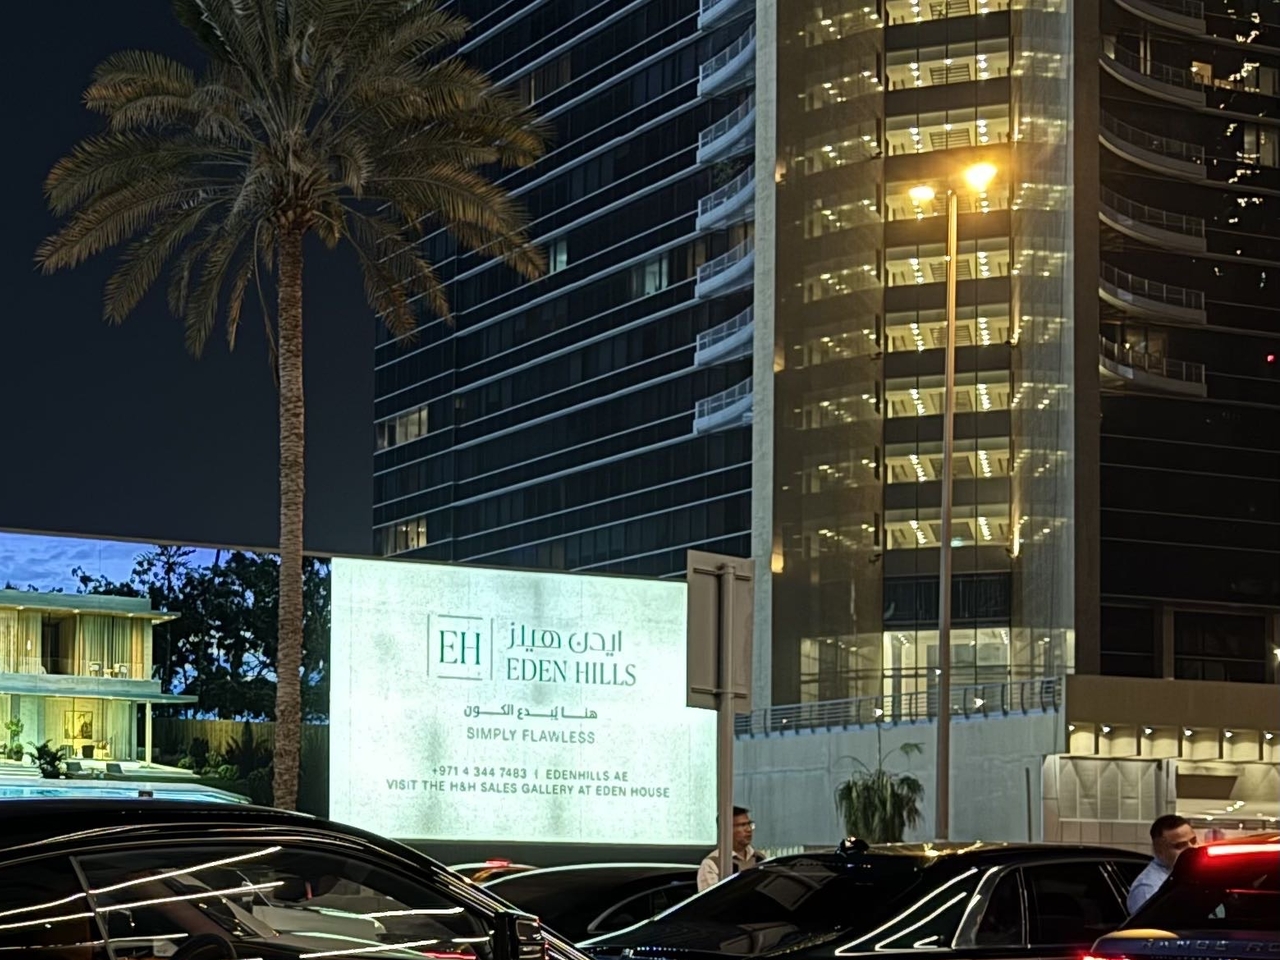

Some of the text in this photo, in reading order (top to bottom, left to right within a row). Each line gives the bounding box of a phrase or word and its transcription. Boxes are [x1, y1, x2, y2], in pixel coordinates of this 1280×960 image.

[438, 629, 481, 665] EH
[506, 657, 637, 687] EDEN HILLS
[466, 727, 596, 745] SIMPLY FLAWLESS
[431, 765, 459, 776] +971
[462, 766, 470, 775] 4
[473, 766, 496, 777] 344
[499, 767, 528, 779] 7483
[386, 779, 671, 798] VISIT THE H&H SALES GALLERY AT EDEN HOUSE
